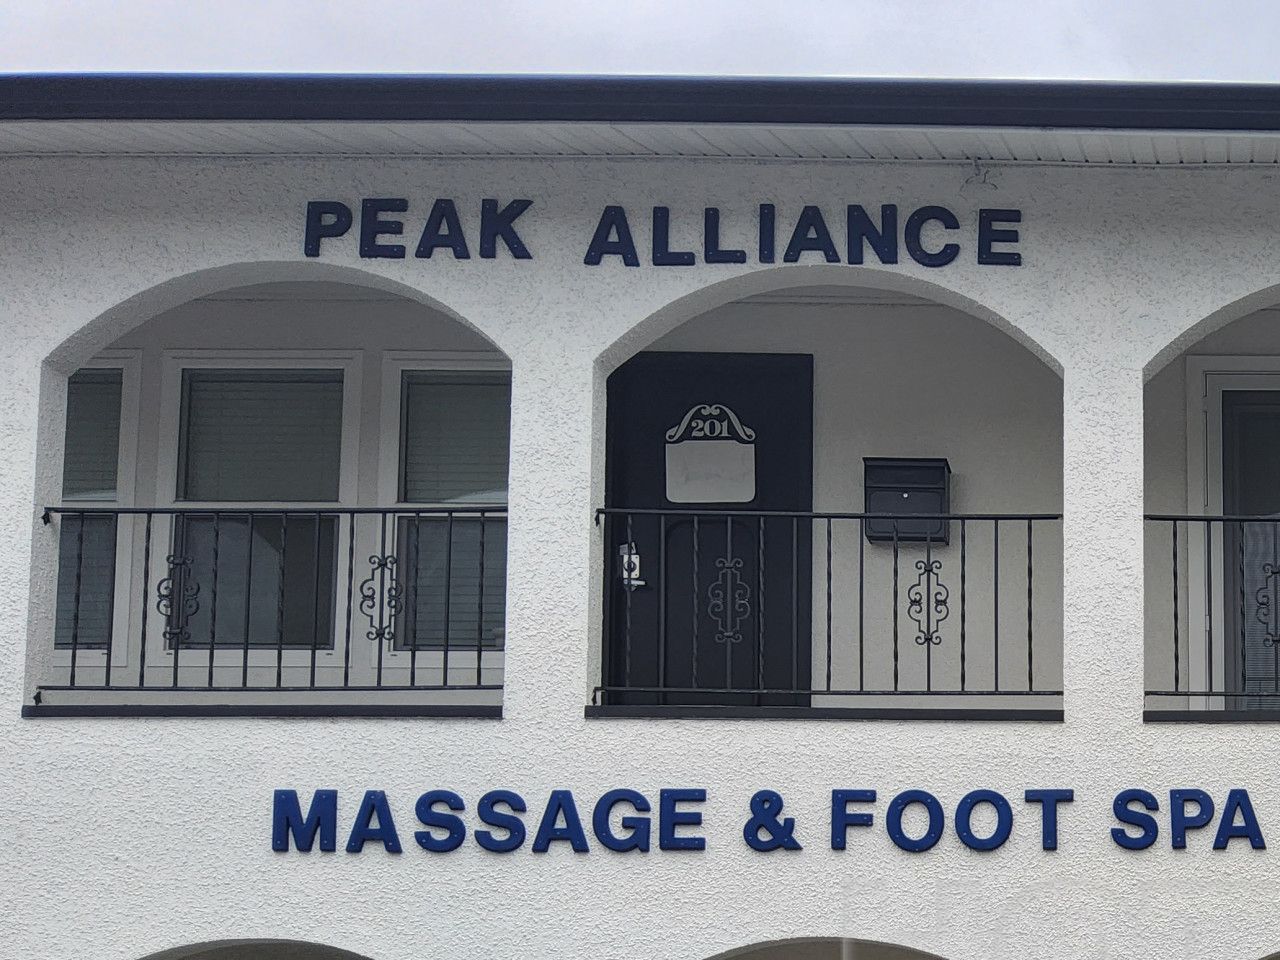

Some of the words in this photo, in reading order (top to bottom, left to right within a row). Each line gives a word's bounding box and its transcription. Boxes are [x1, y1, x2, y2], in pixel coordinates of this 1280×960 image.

[304, 198, 534, 261] PEAK
[583, 204, 1022, 267] ALLIANCE
[691, 418, 731, 438] 201
[272, 789, 706, 854] MASSAGE
[743, 790, 803, 853] &
[832, 789, 1073, 852] FOOT
[1110, 788, 1267, 852] SPA
